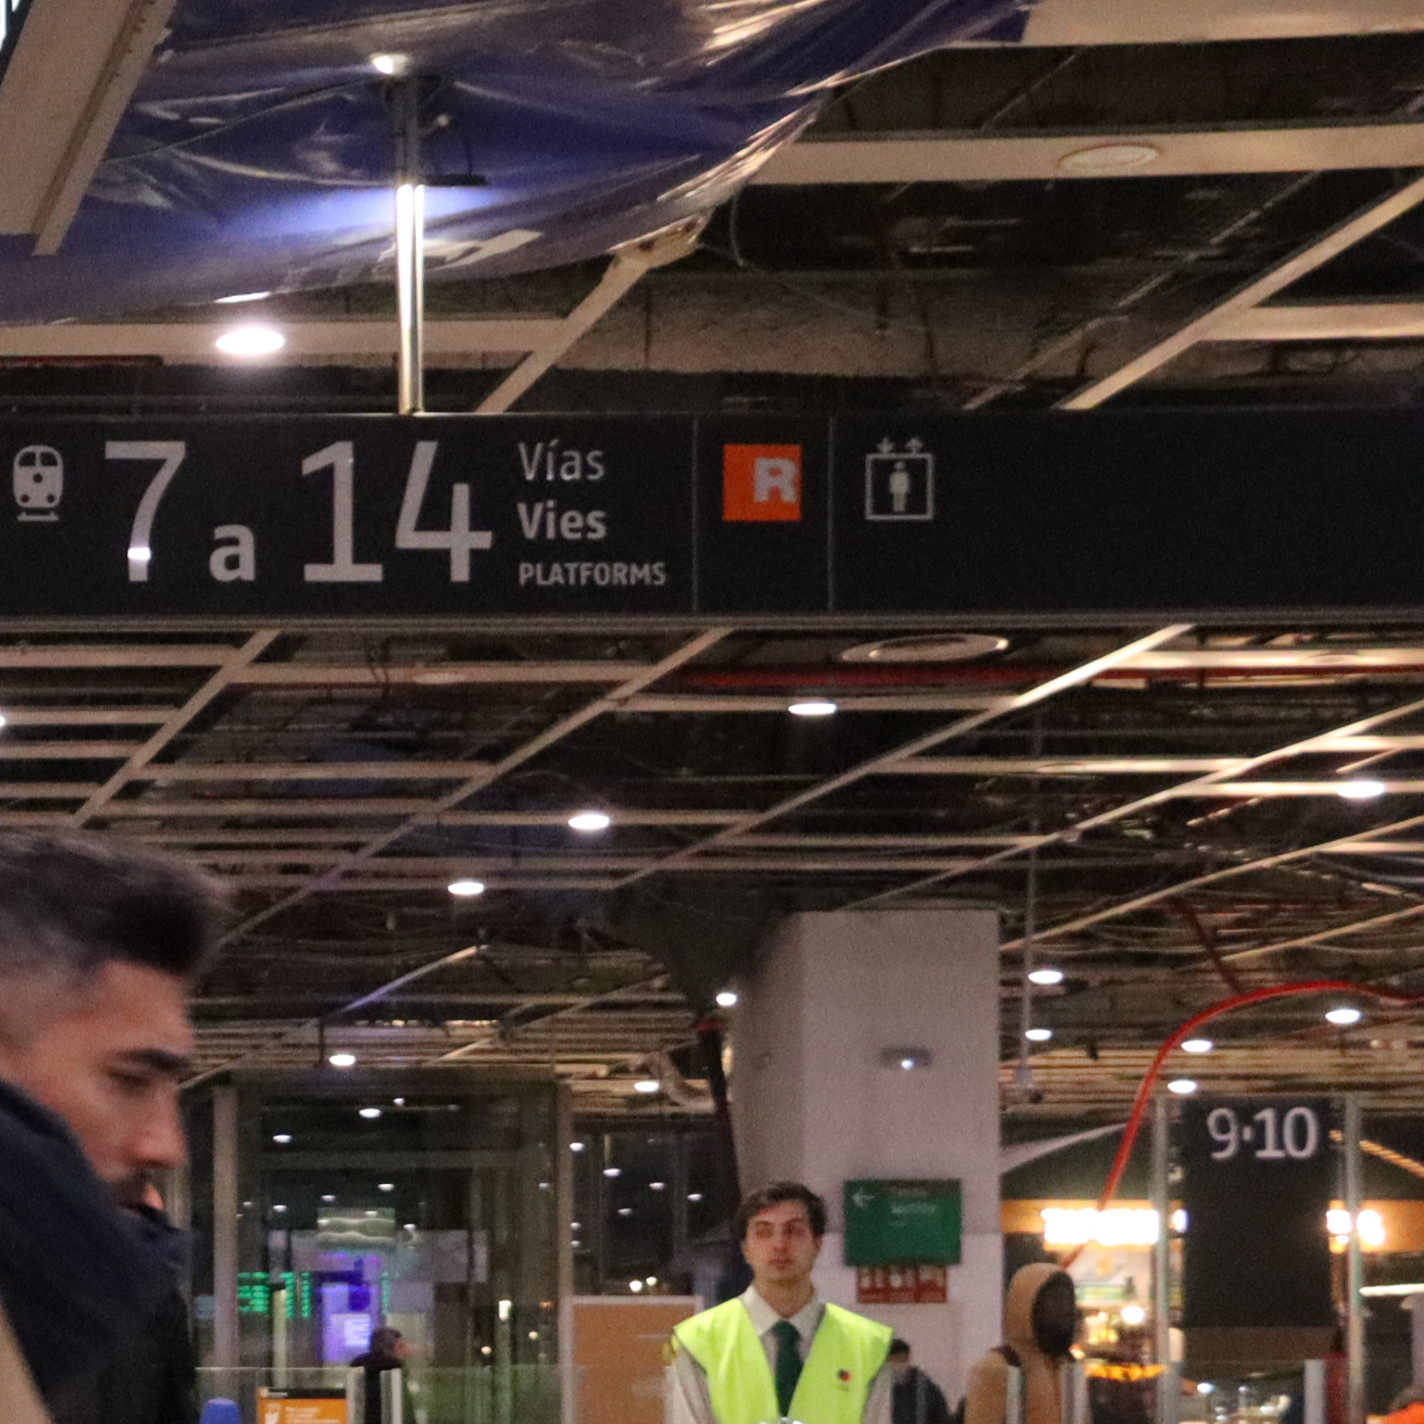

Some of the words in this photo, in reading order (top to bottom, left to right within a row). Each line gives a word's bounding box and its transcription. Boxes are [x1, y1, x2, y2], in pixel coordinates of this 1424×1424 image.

[518, 441, 605, 482] Vías
[753, 456, 798, 504] R
[105, 440, 186, 582] 7
[208, 523, 256, 582] a
[301, 440, 493, 583] 14
[518, 499, 607, 540] Vies
[518, 560, 667, 588] PLATFORMS
